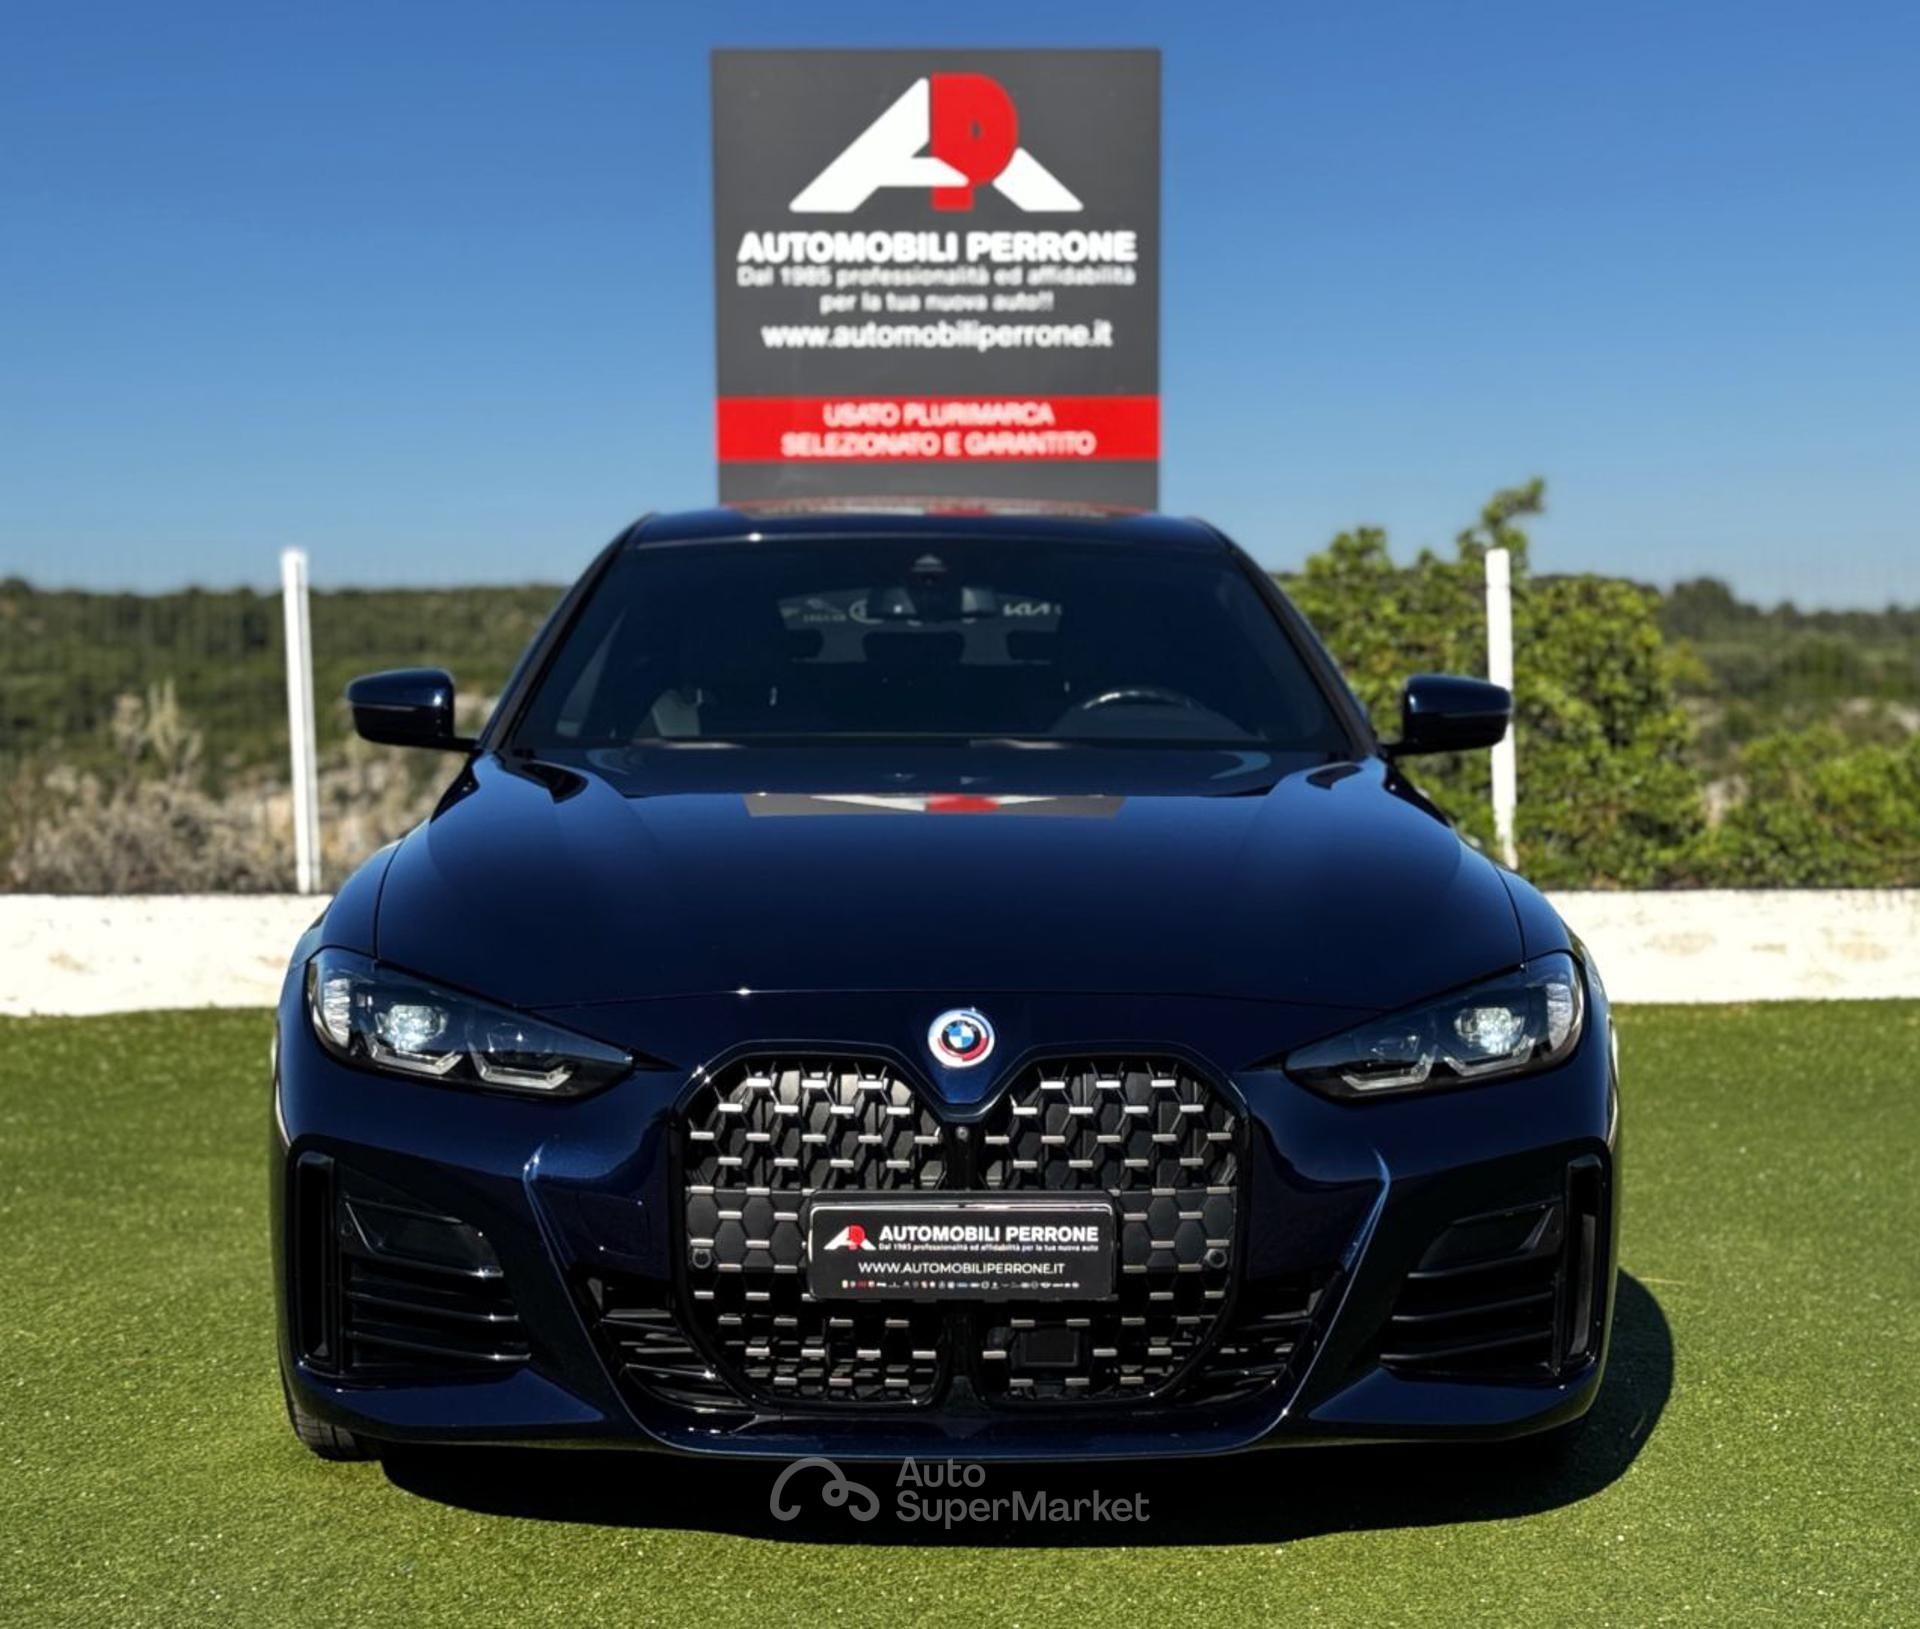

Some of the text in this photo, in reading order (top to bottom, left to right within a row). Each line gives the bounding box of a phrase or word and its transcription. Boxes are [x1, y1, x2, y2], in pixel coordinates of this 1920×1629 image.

[737, 231, 1138, 263] AUTOMOBILI PERRONE
[993, 265, 1023, 287] ed
[819, 294, 857, 316] per
[861, 291, 882, 312] la
[885, 292, 921, 312] tua
[925, 294, 988, 312] nuova
[761, 319, 1113, 353] www.automobiliperrone.it
[823, 402, 1056, 427] USATO PLURIMARCA
[781, 431, 1097, 456] SELEZIONATO E GARANTITO
[879, 1225, 1099, 1242] AUTOMOBILI PERRONE
[878, 1243, 892, 1252] Dal
[857, 1262, 1066, 1275] WWW.AUTOMOBILIPERRONE.IT
